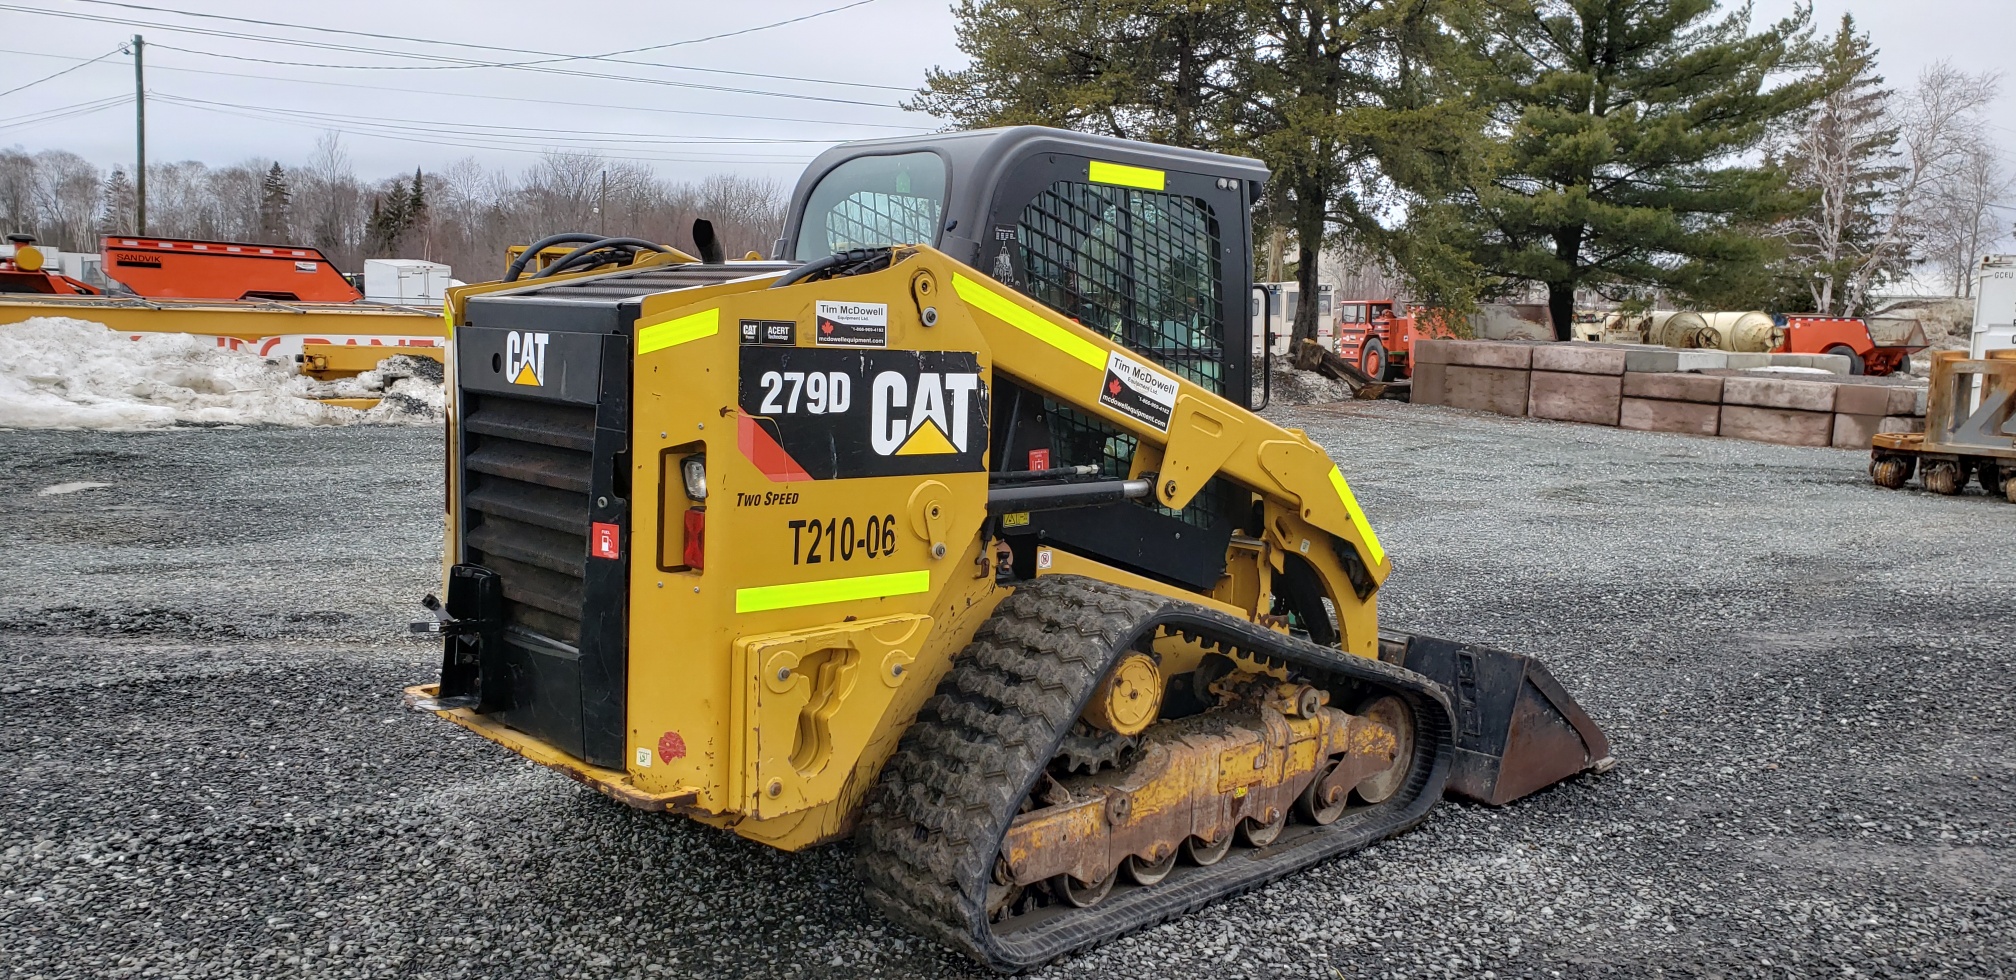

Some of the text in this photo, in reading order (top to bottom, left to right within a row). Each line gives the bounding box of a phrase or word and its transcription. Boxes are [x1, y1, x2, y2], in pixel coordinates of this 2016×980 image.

[117, 254, 160, 262] SANDVIK
[820, 304, 883, 316] Tim McDowell
[743, 324, 757, 335] CAT
[767, 326, 790, 335] ACERT
[506, 330, 549, 387] CAT
[1114, 357, 1174, 394] Tim McDowell
[1127, 376, 1150, 391] Equipment
[760, 370, 851, 414] 279D
[871, 370, 978, 456] CAT
[1103, 395, 1165, 427] mcdowellequipment.com
[788, 513, 896, 566] T210-06
